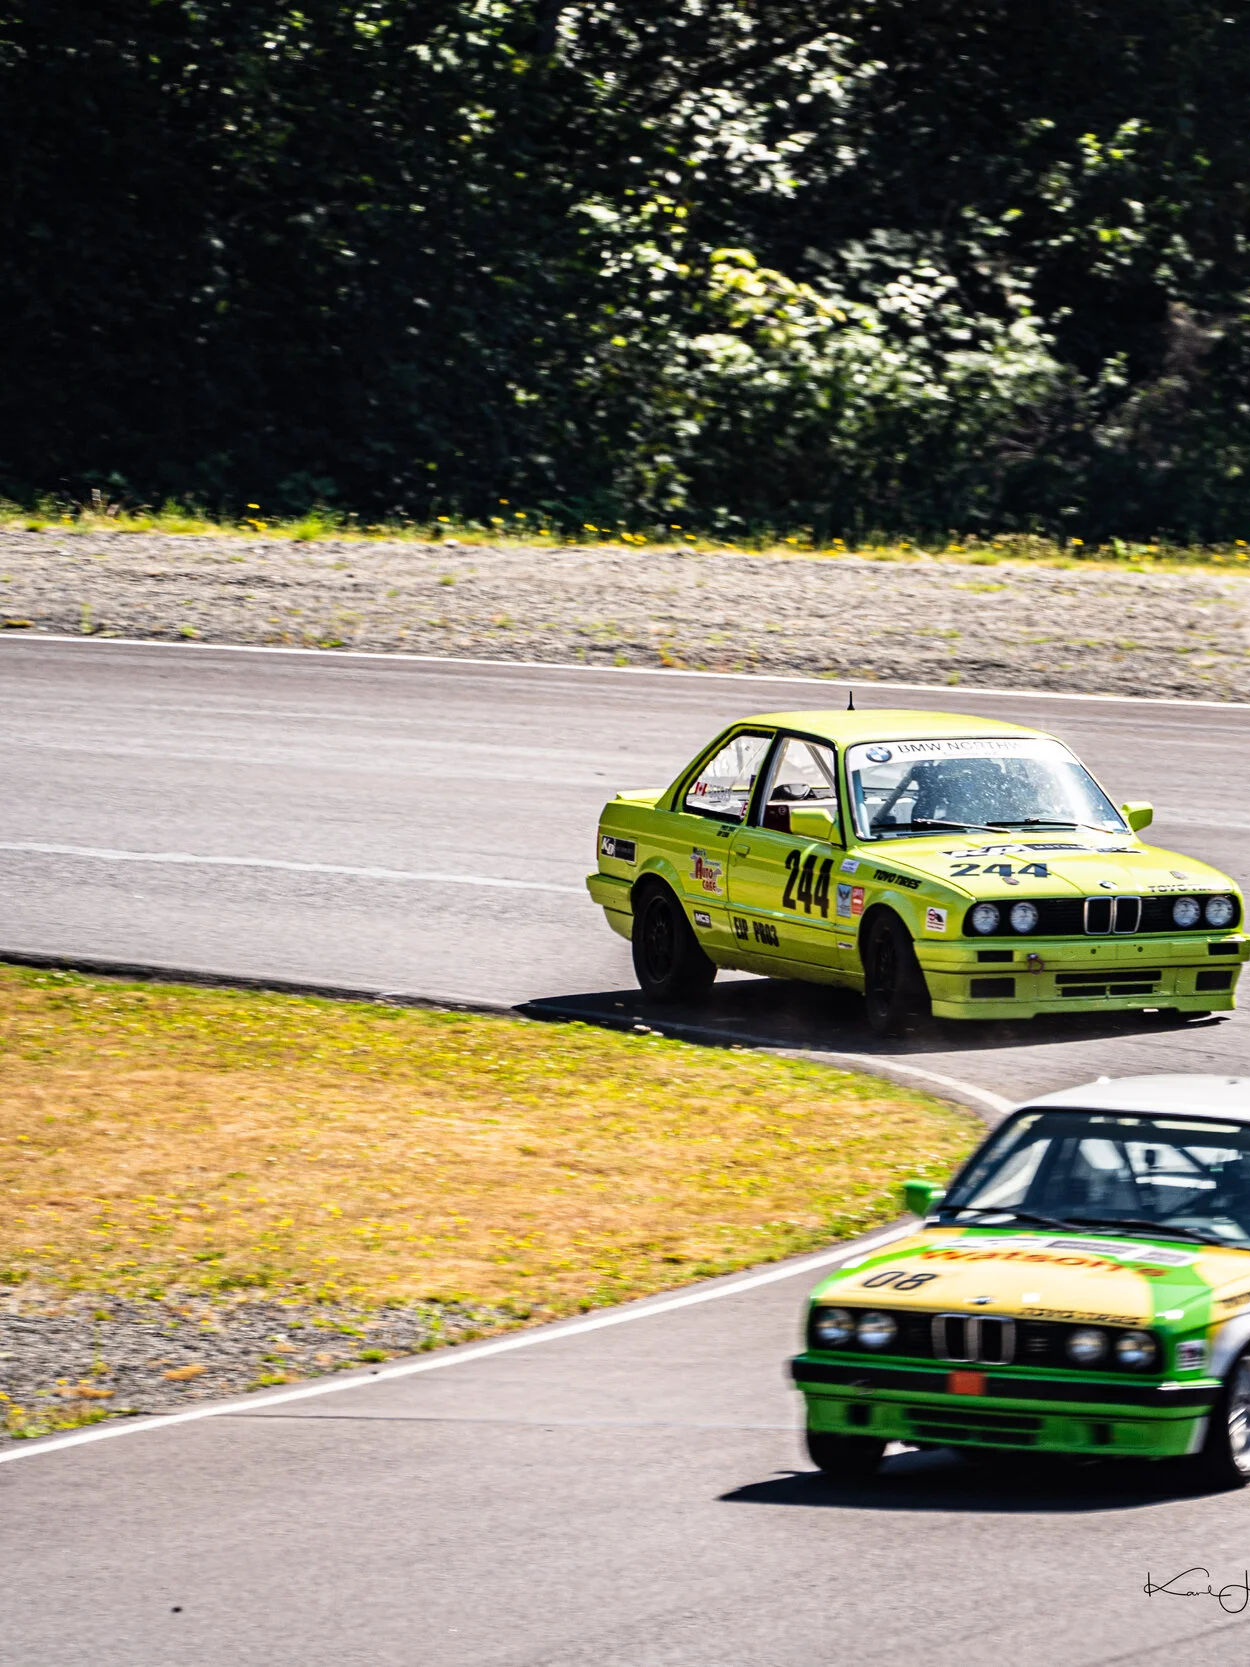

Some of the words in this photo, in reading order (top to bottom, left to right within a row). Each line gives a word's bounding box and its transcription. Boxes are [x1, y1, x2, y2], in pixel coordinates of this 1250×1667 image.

[897, 742, 942, 754] BMW
[873, 868, 895, 883] TOYO
[895, 874, 922, 889] TIRES
[949, 863, 1052, 878] 244
[783, 849, 835, 919] 244
[919, 1249, 1171, 1278] Watson's
[862, 1271, 940, 1291] 08
